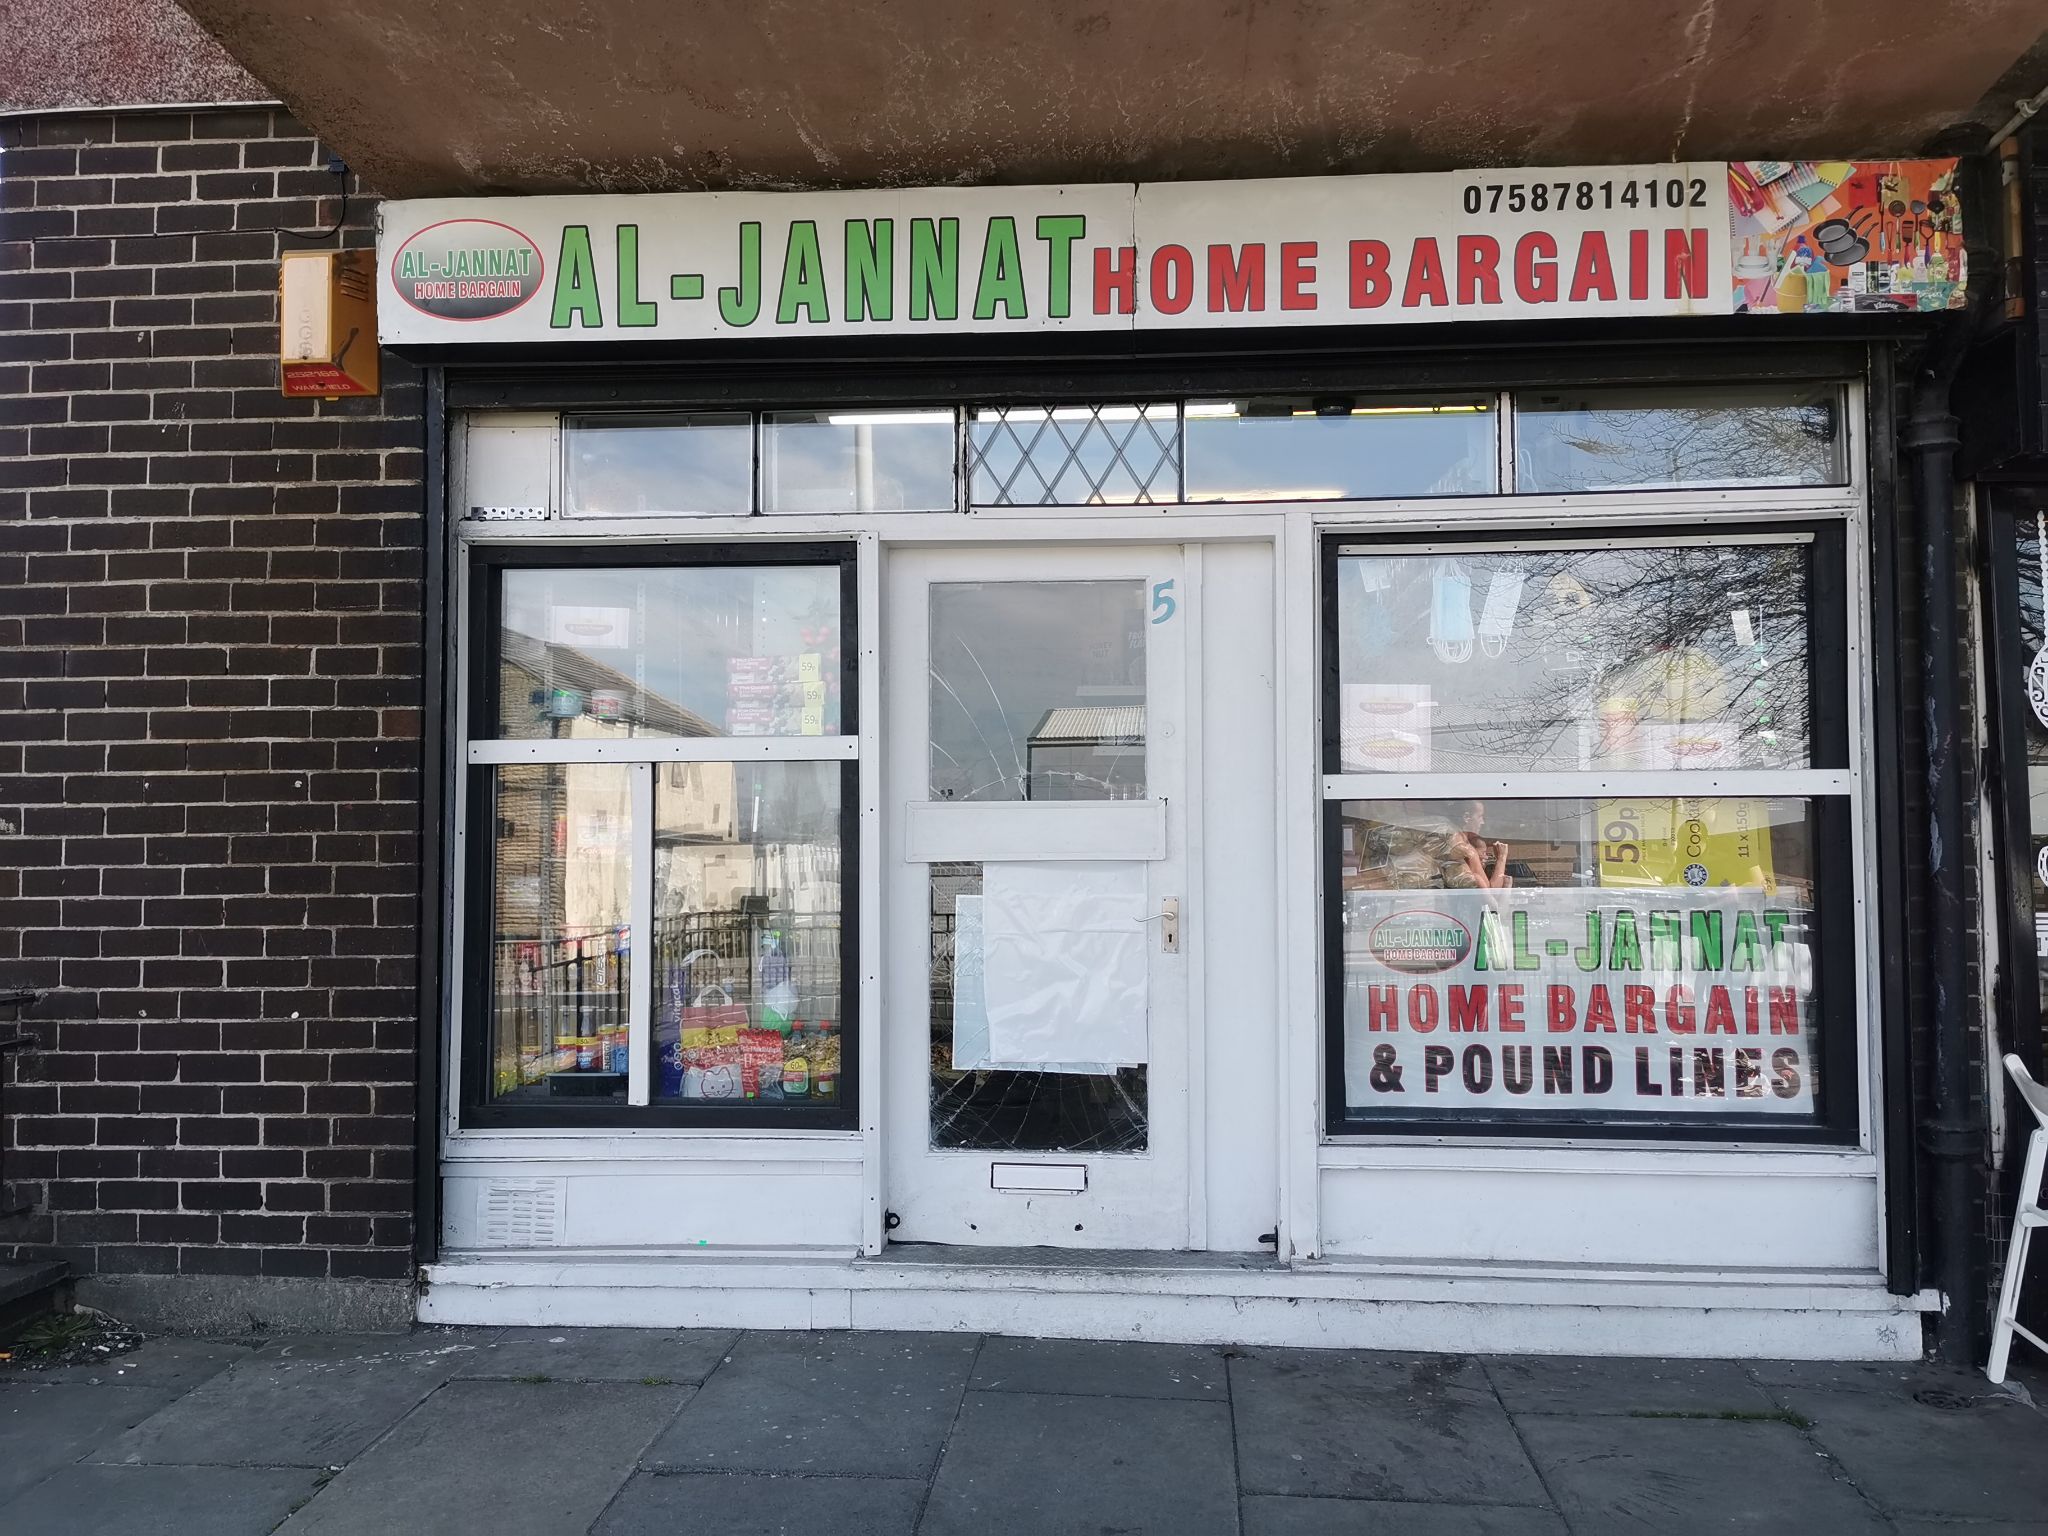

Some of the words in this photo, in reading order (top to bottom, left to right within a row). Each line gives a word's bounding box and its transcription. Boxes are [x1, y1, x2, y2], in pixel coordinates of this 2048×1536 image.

[1463, 178, 1708, 215] 07587814102
[401, 248, 533, 279] AL-JANNAT
[549, 214, 1086, 329] AL-JANNAT
[1093, 240, 1318, 316] HOME
[1348, 227, 1709, 310] BARGAIN
[414, 281, 457, 300] HOME
[458, 280, 522, 299] BARGAIN
[1151, 578, 1175, 625] 5
[1603, 807, 1640, 864] 59p
[1375, 929, 1464, 948] AL-JANNAT
[1383, 948, 1413, 961] HOME
[1414, 948, 1457, 961] BARGAIN
[1473, 909, 1791, 972] AL-JANNAT
[1368, 984, 1526, 1034] HOME
[1546, 984, 1800, 1035] BARGAIN
[1369, 1044, 1405, 1095] &
[1424, 1044, 1613, 1096] POUND
[1634, 1046, 1802, 1099] LINES
